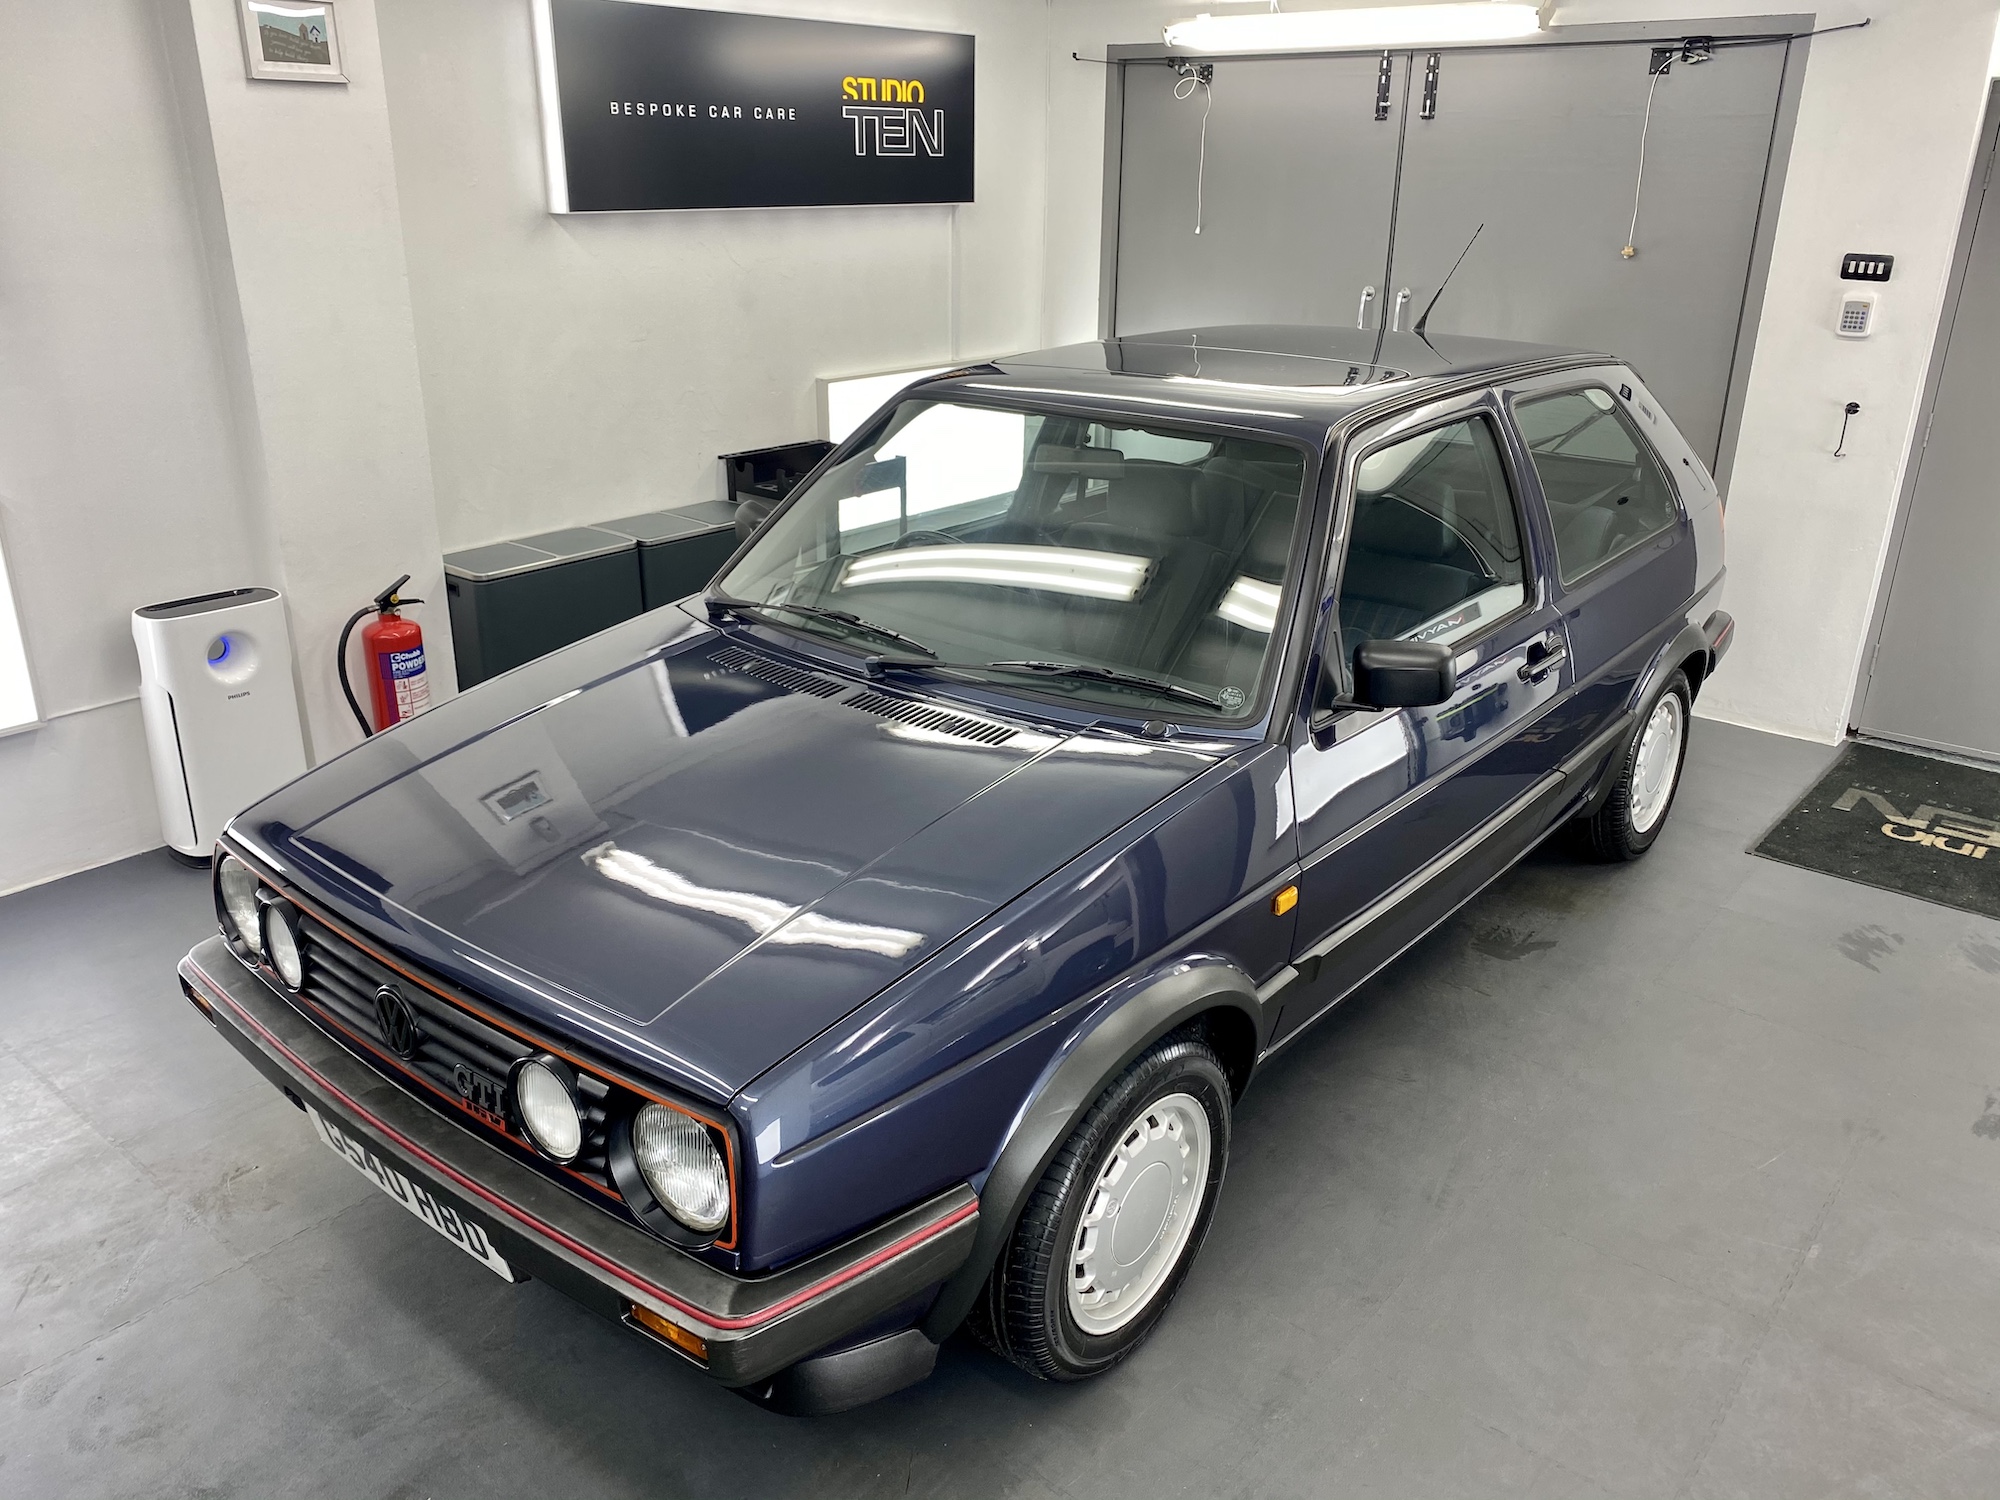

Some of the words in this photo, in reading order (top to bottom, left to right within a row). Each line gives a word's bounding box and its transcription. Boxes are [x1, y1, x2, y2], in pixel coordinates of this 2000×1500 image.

[842, 75, 925, 103] STUDIO
[610, 101, 697, 118] BESPOKE
[708, 105, 743, 119] CAR
[753, 107, 797, 121] CARE
[842, 105, 945, 157] TEN
[391, 655, 425, 671] POWDE
[228, 691, 250, 700] PHILIPS
[453, 1063, 506, 1118] GTI
[411, 1179, 490, 1261] HBD
